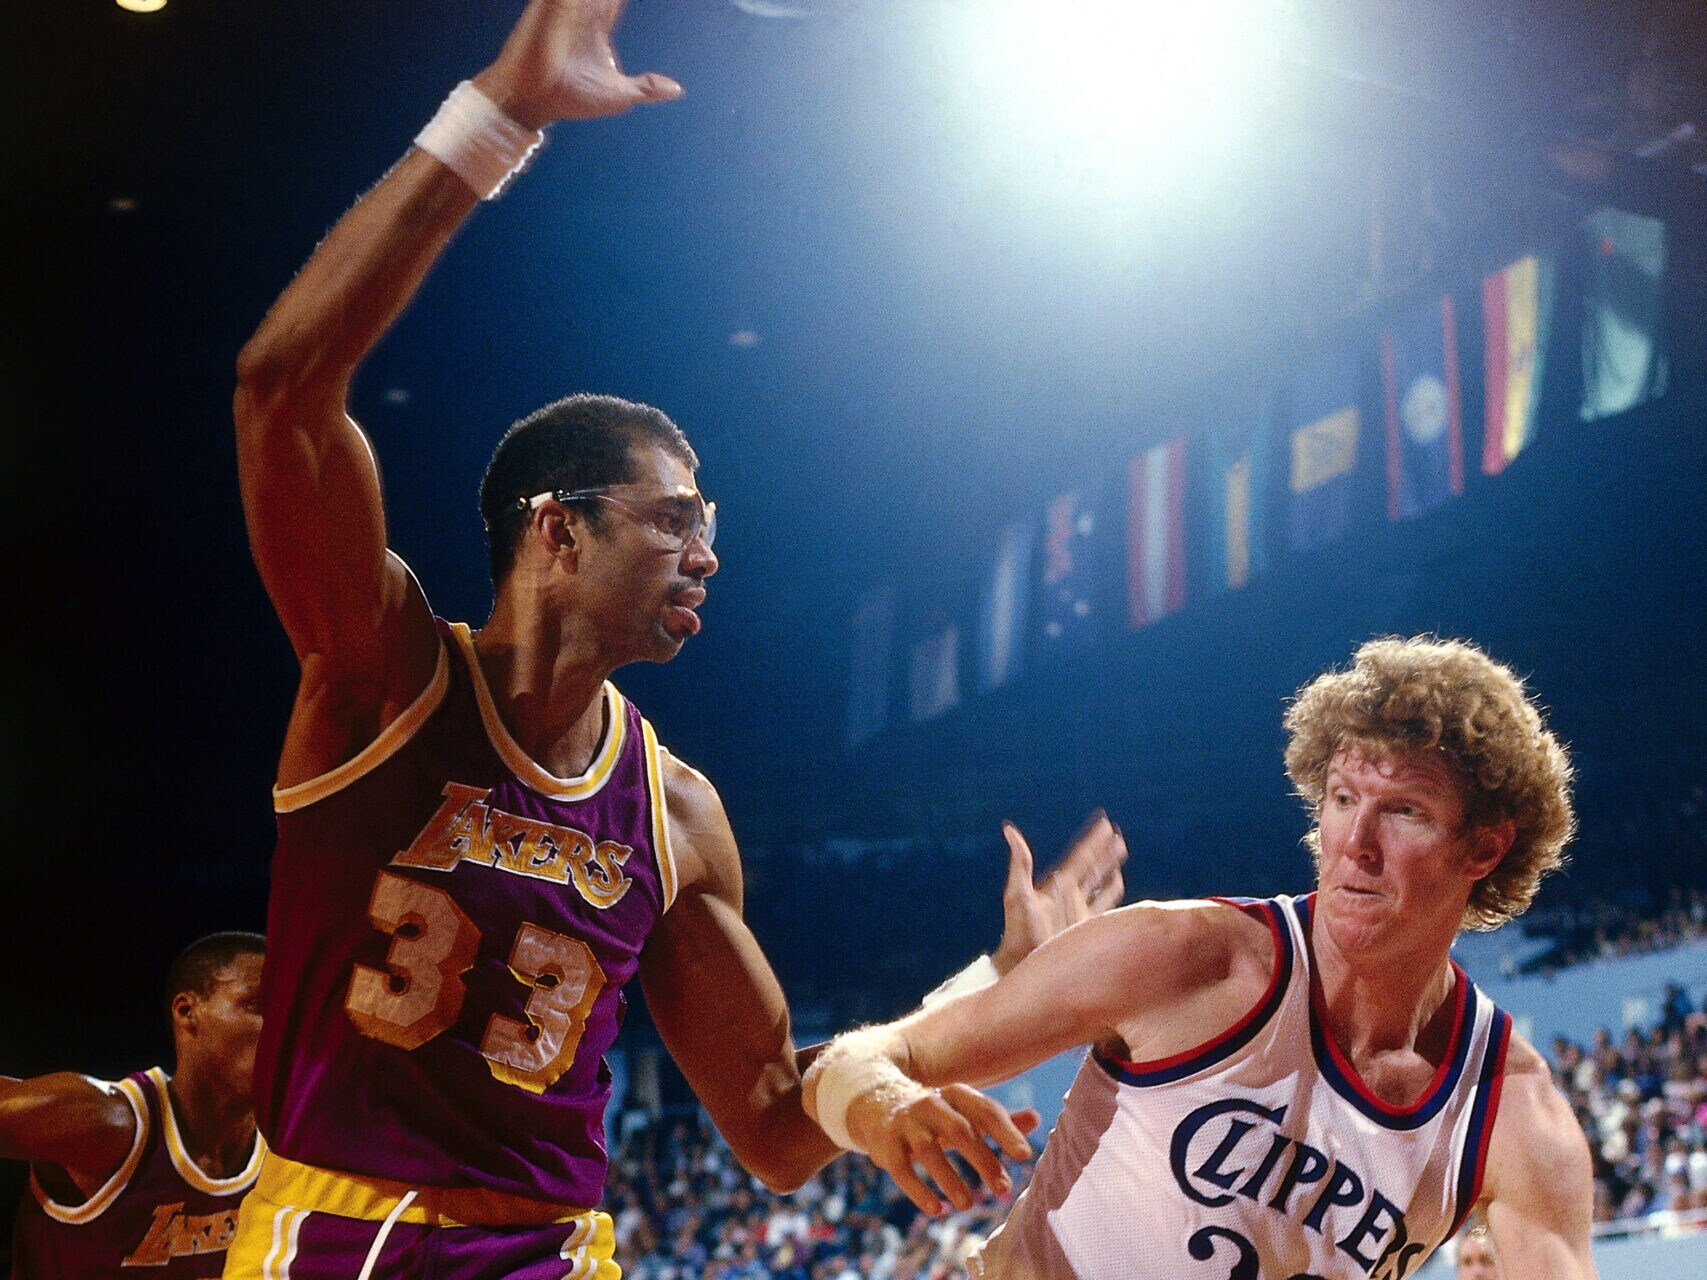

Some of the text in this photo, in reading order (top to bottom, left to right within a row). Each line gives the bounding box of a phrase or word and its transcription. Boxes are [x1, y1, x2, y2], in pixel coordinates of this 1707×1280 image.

[387, 780, 634, 910] LAKERS
[344, 868, 607, 1096] 33
[120, 1201, 240, 1267] LAKE
